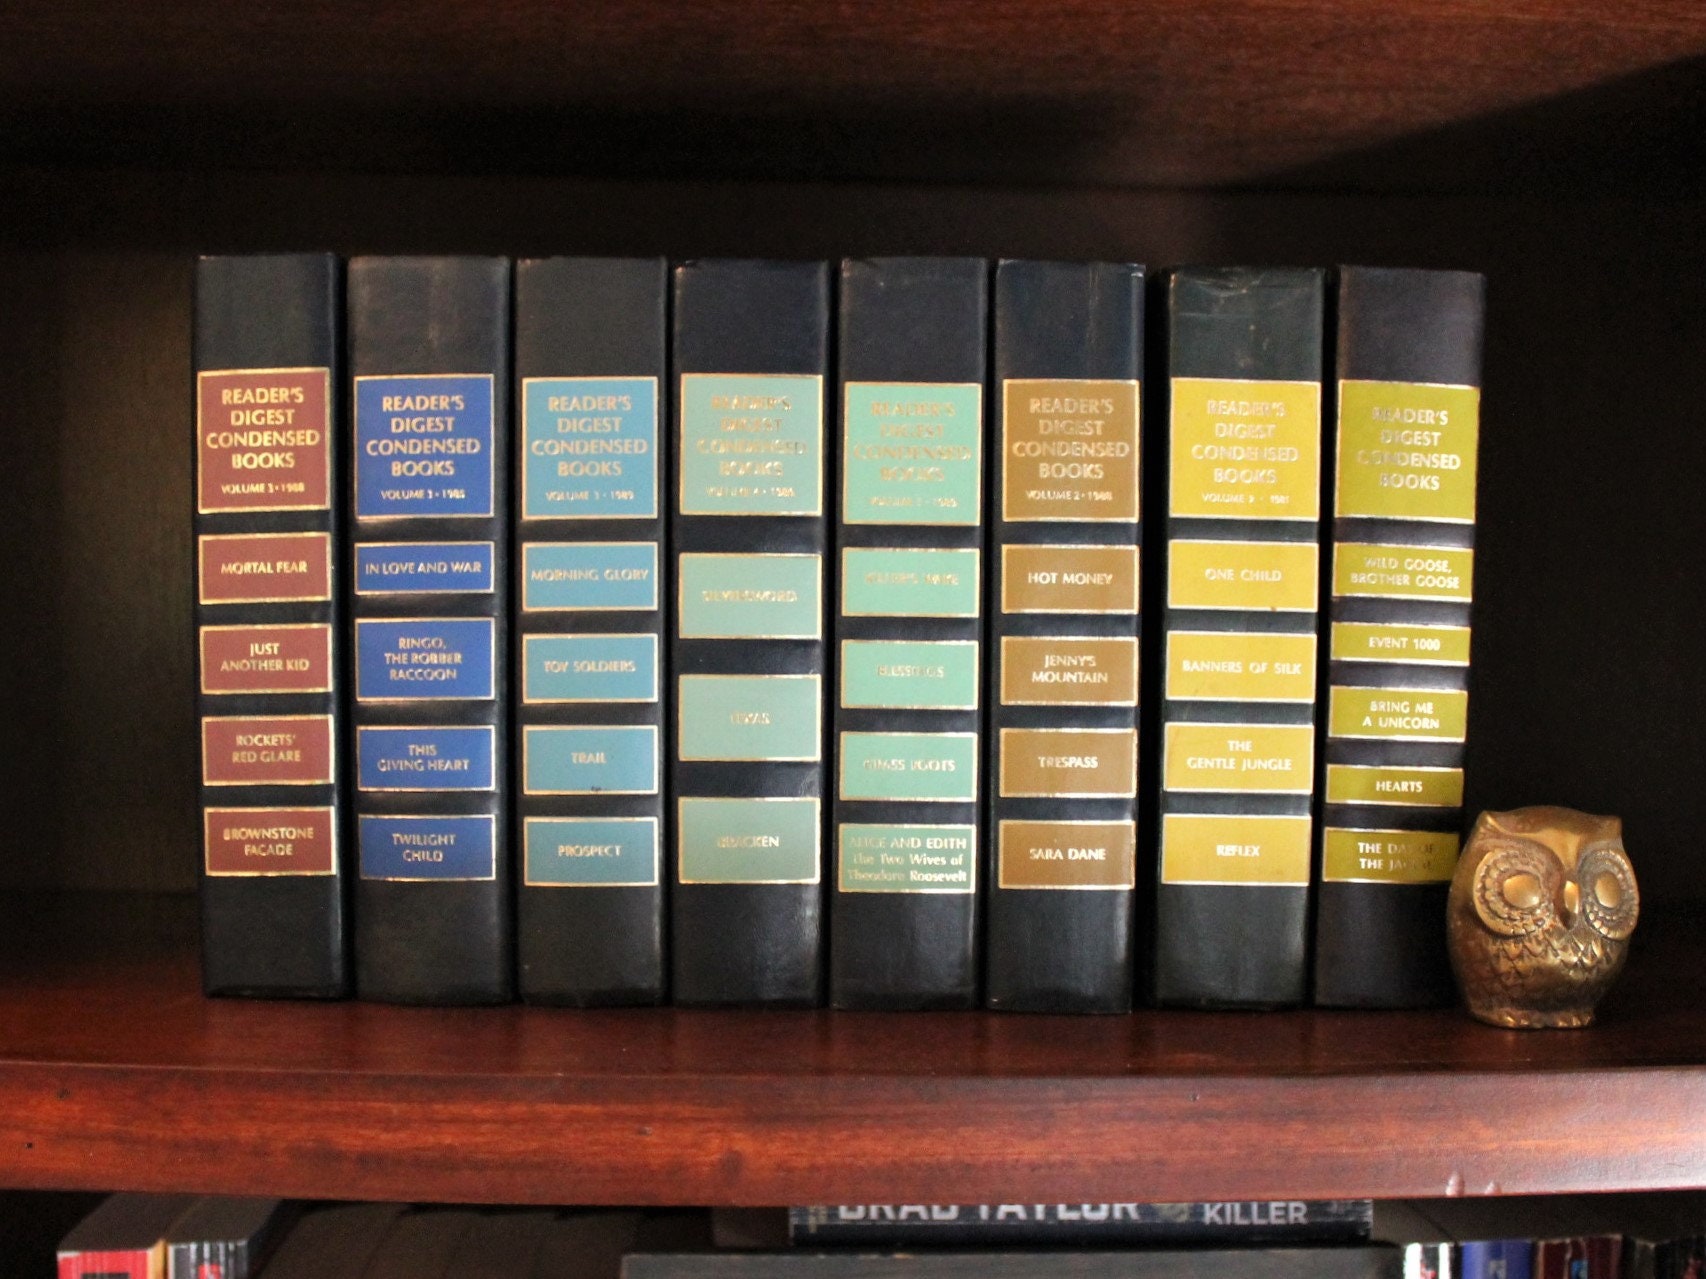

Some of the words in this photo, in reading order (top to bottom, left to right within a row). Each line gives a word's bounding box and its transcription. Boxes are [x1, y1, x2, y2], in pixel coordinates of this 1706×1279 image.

[222, 387, 304, 404] READER'S
[382, 395, 464, 412] READER'S
[548, 396, 632, 412] READER'S
[1029, 398, 1114, 414] READER'S
[1207, 400, 1287, 417] READER'S
[230, 409, 294, 426] DIGEST
[1372, 406, 1449, 426] READER'S
[391, 417, 454, 433] DIGEST
[557, 417, 622, 433] DIGEST
[1039, 420, 1104, 436] DIGEST
[1215, 423, 1276, 439] DIGEST
[206, 430, 320, 449] CONDENSED
[1381, 429, 1442, 447] DIGEST
[366, 438, 481, 456] CONDENSED
[531, 438, 648, 456] CONDENSED
[1013, 441, 1130, 458] CONDENSED
[1191, 445, 1299, 463] CONDENSED
[232, 452, 295, 469] BOOKS
[1357, 450, 1461, 470] CONDENSED
[391, 461, 454, 477] BOOKS
[558, 461, 622, 476] BOOKS
[719, 461, 783, 477] BOOKS
[881, 466, 945, 482] BOOKS
[1039, 463, 1104, 479] BOOKS
[1213, 468, 1276, 484] BOOKS
[1380, 473, 1440, 491] BOOKS
[221, 483, 266, 494] VOLUME
[381, 490, 424, 500] VOLUME
[1026, 489, 1072, 501] VOLUME
[1073, 490, 1081, 500] 2
[546, 491, 590, 502] VOLUME
[1202, 492, 1245, 504] VOLUME
[221, 563, 273, 575] MORTAL
[276, 562, 307, 574] FEAR
[365, 563, 379, 575] IN
[382, 562, 415, 575] LOVE
[417, 562, 447, 574] AND
[450, 561, 482, 574] WAR
[1364, 557, 1399, 569] WILD
[1404, 558, 1452, 574] GOOSE,
[531, 569, 599, 581] MORNING
[604, 569, 649, 581] GLORY
[1028, 572, 1058, 584] HOT
[1063, 572, 1113, 585] MONEY
[1205, 569, 1234, 581] ONE
[1240, 569, 1282, 582] CHILD
[1350, 573, 1410, 586] BROTHER
[1416, 575, 1460, 589] GOOSE
[250, 643, 280, 656] JUST
[1368, 637, 1408, 649] EVENT
[1413, 638, 1441, 650] 1000
[220, 659, 283, 672] ANOTHER
[286, 659, 310, 671] KID
[384, 653, 408, 665] THE
[411, 652, 462, 665] ROBBER
[1044, 654, 1096, 668] JENNY'S
[544, 661, 568, 673] TOY
[573, 660, 636, 673] SOLDIERS
[1182, 660, 1242, 673] BANNERS
[1250, 662, 1268, 674] OF
[1274, 663, 1301, 675] SILK
[389, 668, 457, 681] RACCOON
[1032, 671, 1108, 683] MOUNTAIN
[1370, 700, 1410, 714] BRING
[1415, 701, 1434, 714] ME
[1362, 716, 1372, 727] A
[1378, 716, 1440, 729] UNICORN
[236, 734, 296, 746] ROCKETS'
[1227, 740, 1253, 752] THE
[232, 751, 258, 763] RED
[260, 750, 301, 762] GLARE
[408, 744, 437, 757] THIS
[571, 752, 606, 764] TRAIL
[1038, 756, 1098, 768] TRESPASS
[1187, 757, 1236, 770] GENTLE
[1241, 758, 1292, 771] JUNGLE
[377, 760, 424, 771] GIVING
[428, 760, 469, 771] HEART
[1375, 780, 1423, 792] HEARTS
[223, 827, 314, 841] BROWNSTONE
[392, 833, 456, 846] TWILIGHT
[890, 836, 922, 849] AND
[925, 837, 967, 849] EDITH
[1358, 842, 1382, 854] THE
[403, 850, 443, 862] CHILD
[558, 845, 621, 857] PROSPECT
[1030, 848, 1064, 860] SARA
[1068, 848, 1106, 861] DANE
[1216, 845, 1260, 857] REFLEX
[880, 853, 905, 866] Two
[908, 854, 947, 867] Wives
[950, 853, 964, 866] of
[1359, 858, 1384, 870] THE
[909, 869, 967, 883] Roosevelt
[1203, 1201, 1308, 1226] KILLER
